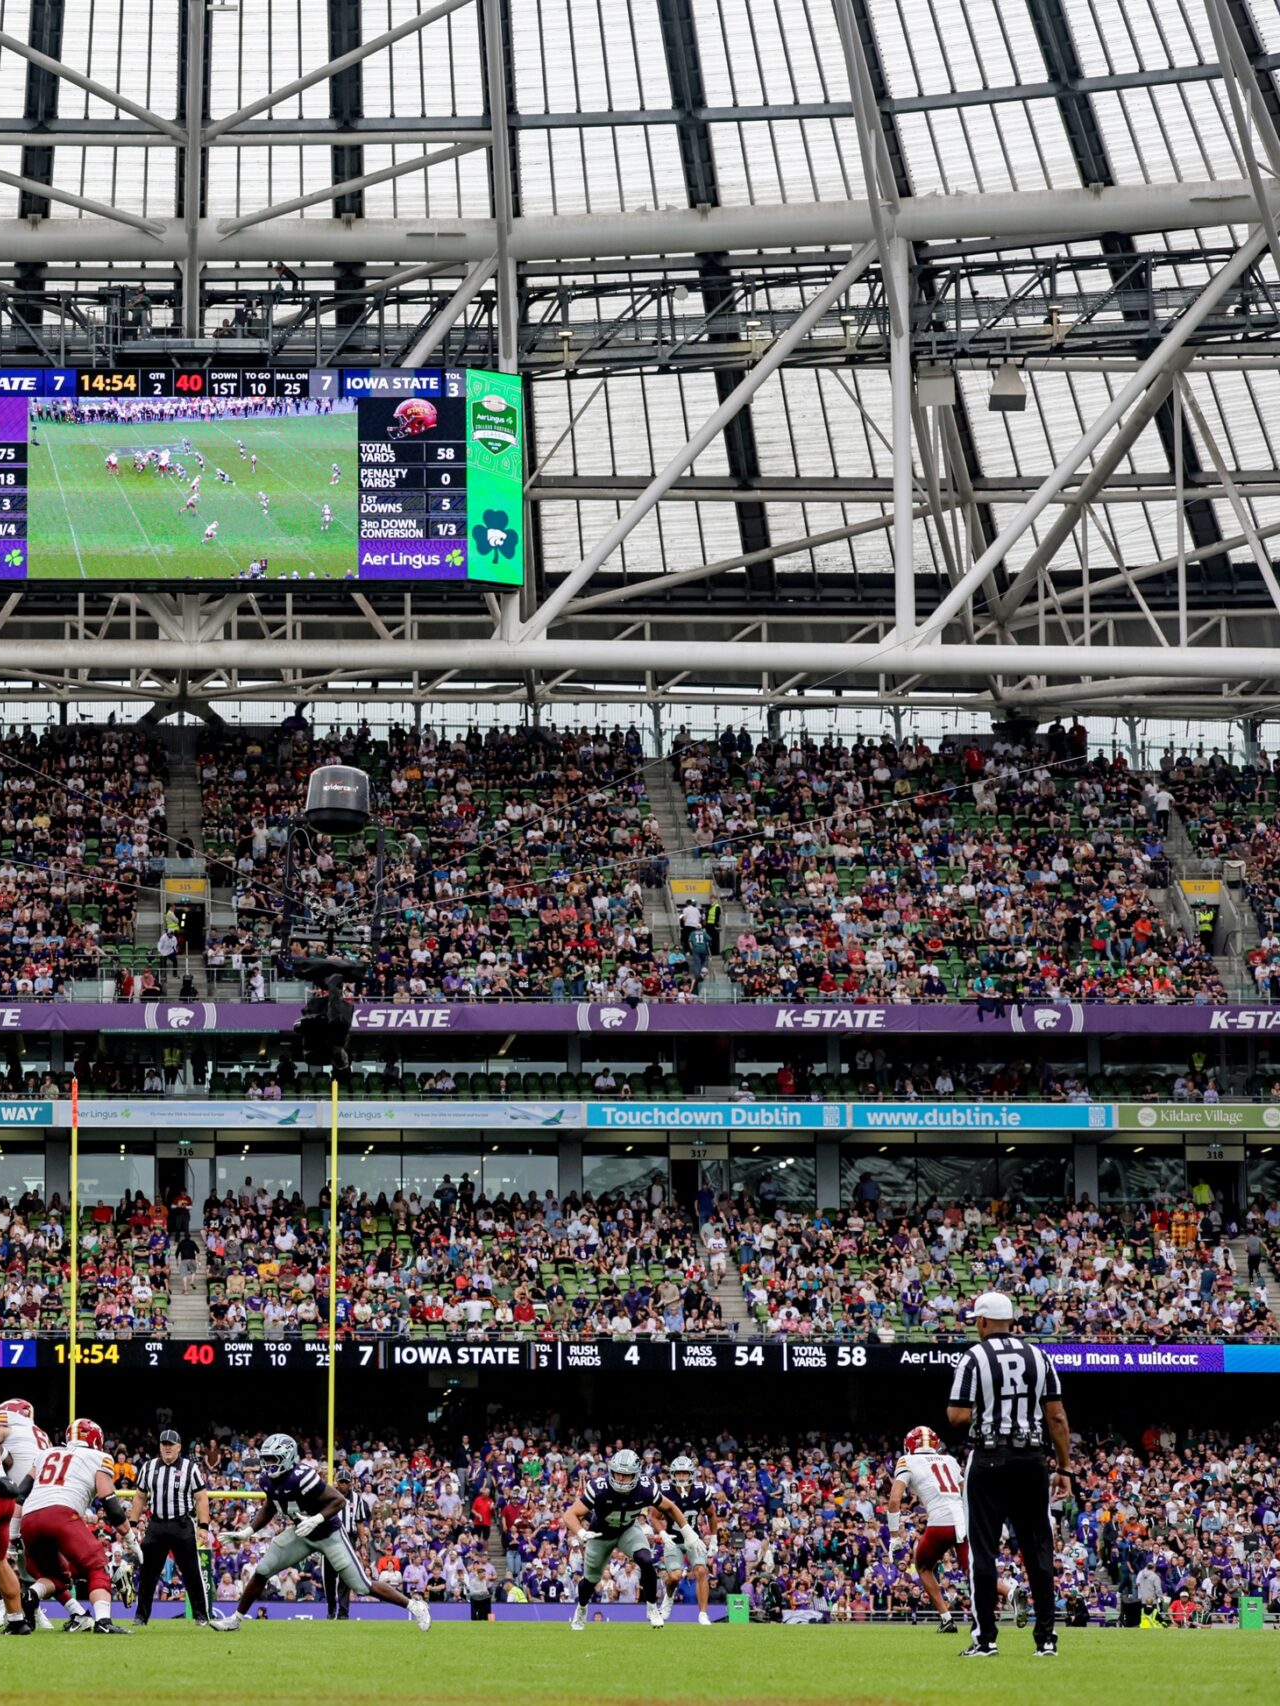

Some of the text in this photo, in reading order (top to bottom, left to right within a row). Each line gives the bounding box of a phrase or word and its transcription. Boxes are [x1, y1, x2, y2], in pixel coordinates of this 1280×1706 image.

[53, 376, 65, 390] 7
[81, 374, 136, 391] 14:54
[153, 383, 162, 394] 2
[176, 374, 202, 391] 40
[321, 376, 332, 391] 7
[346, 377, 439, 389] IOWA STATE
[213, 383, 237, 395] 1ST
[250, 383, 266, 395] 10
[284, 383, 301, 395] 25
[448, 384, 459, 397] 3
[360, 444, 394, 453] TOTAL
[437, 448, 455, 460] 58
[360, 453, 396, 463] YARDS
[361, 469, 408, 479] PENALTY
[441, 473, 451, 485] 0
[361, 478, 396, 488] YARDS
[2, 499, 11, 511] 3
[361, 494, 377, 504] 1ST
[441, 499, 451, 511] 5
[361, 503, 403, 513] DOWNS
[361, 519, 417, 529] 3RD DOWN
[437, 524, 456, 536] 1/3
[361, 529, 424, 538] CONVERSION
[362, 552, 440, 569] Aer Lingus
[775, 1009, 885, 1028] K-STATE
[0, 1107, 39, 1120] WAY
[90, 1110, 118, 1120] Lingus
[338, 1110, 382, 1121] Aer Lingus
[601, 1106, 724, 1125] Touchdown
[730, 1106, 801, 1125] Dublin
[866, 1107, 1022, 1126] www.dublin.ie
[1160, 1109, 1243, 1124] Kildare Village
[176, 1148, 194, 1156] 316
[691, 1149, 708, 1158] 317
[1206, 1151, 1224, 1159] 318
[145, 1342, 163, 1351] QTR
[224, 1343, 253, 1351] DOWN
[264, 1343, 292, 1351] TO GO
[305, 1343, 327, 1351] BALL
[535, 1344, 553, 1352] TOL
[569, 1346, 599, 1355] RUSH
[686, 1346, 713, 1356] PASS
[792, 1347, 826, 1356] TOTAL
[9, 1345, 24, 1364] 7
[54, 1344, 120, 1364] 14:54
[149, 1354, 158, 1366] 2
[183, 1344, 214, 1365] 40
[227, 1354, 252, 1366] 1ST
[270, 1354, 286, 1366] 10
[358, 1346, 374, 1366] 7
[394, 1347, 520, 1365] IOWA STATE
[624, 1345, 641, 1366] 4
[734, 1346, 764, 1366] 54
[836, 1346, 867, 1367] 58
[900, 1350, 928, 1364] Aer
[539, 1355, 548, 1367] 3
[567, 1355, 602, 1366] YARDS
[682, 1356, 717, 1367] YARDS
[792, 1357, 827, 1368] YARDS
[996, 1353, 1029, 1396] R
[39, 1451, 74, 1487] 61
[931, 1463, 960, 1493] 11
